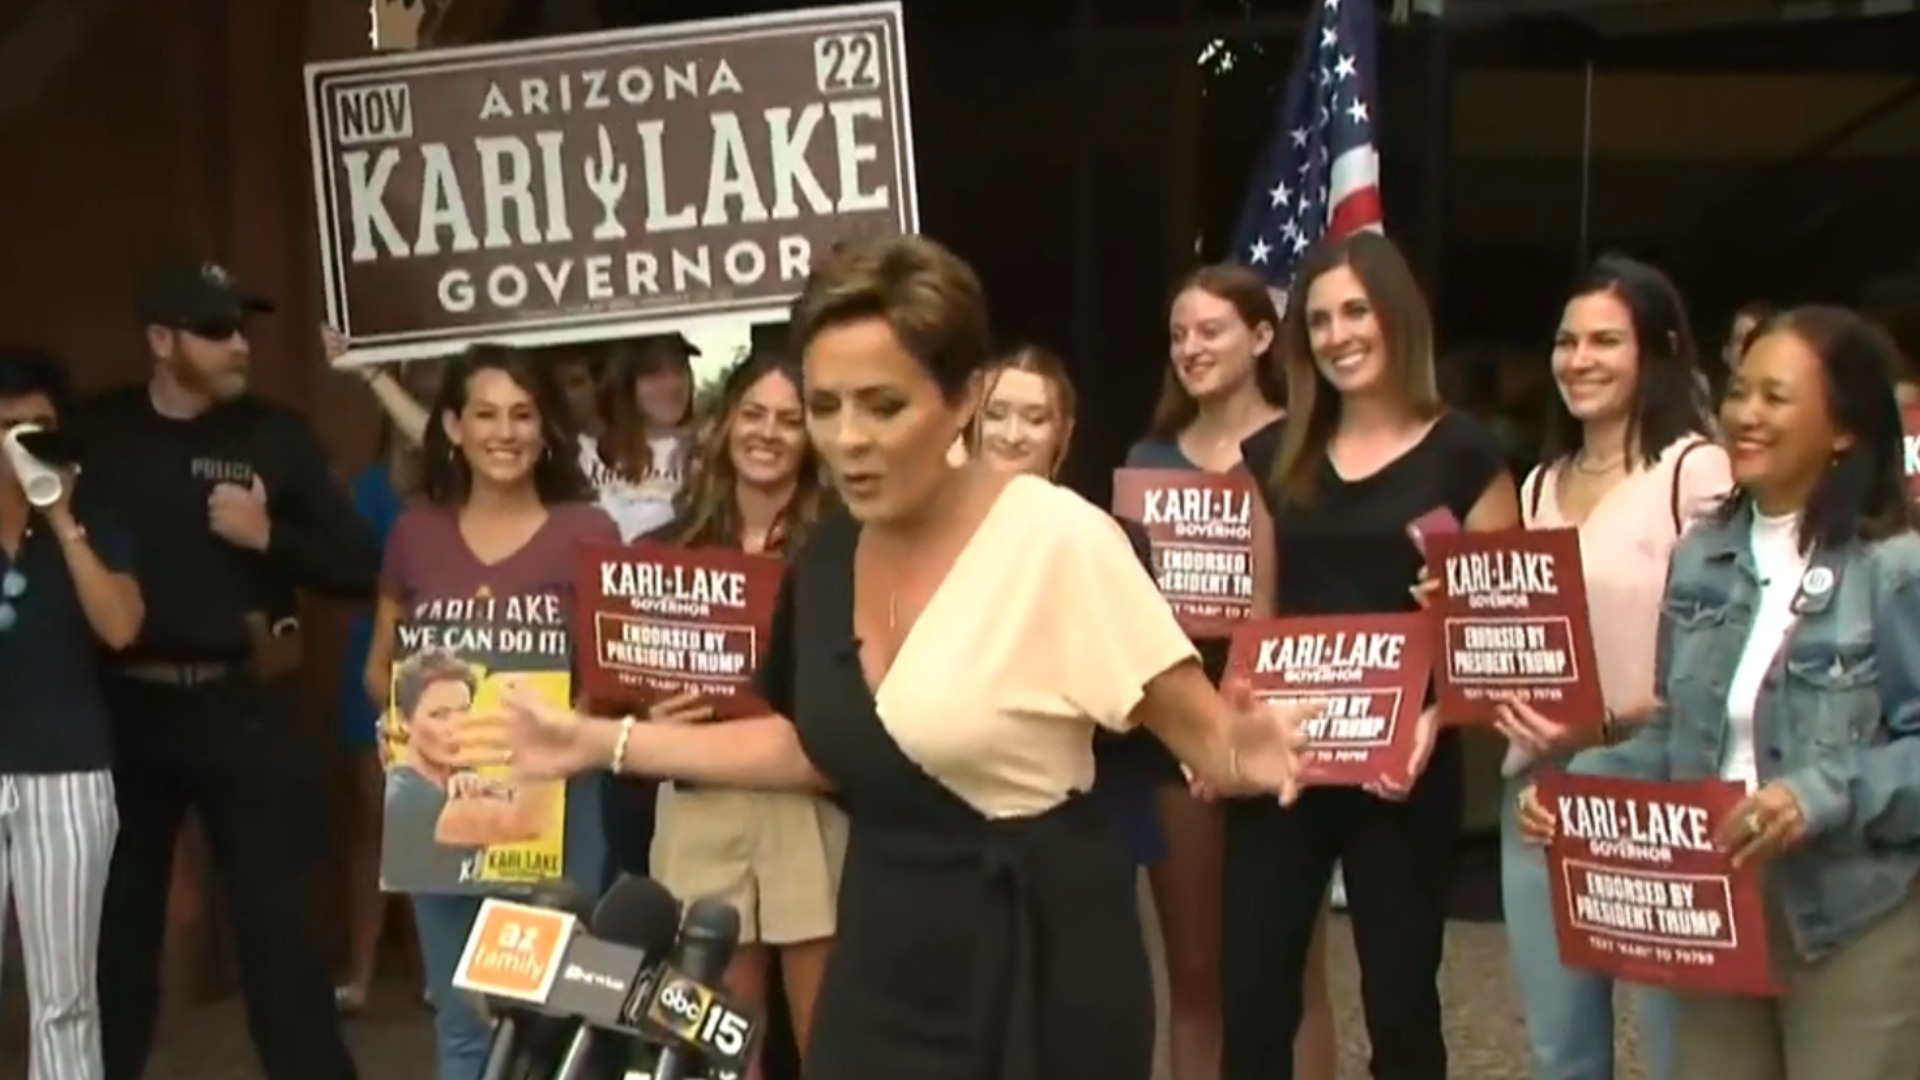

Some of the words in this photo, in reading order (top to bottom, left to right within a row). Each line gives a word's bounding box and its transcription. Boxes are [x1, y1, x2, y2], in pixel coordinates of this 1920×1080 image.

[821, 36, 877, 88] 22
[480, 59, 743, 120] ARIZONA
[341, 87, 406, 137] NOV
[342, 131, 572, 264] KARI
[637, 98, 889, 232] LAKE
[437, 236, 811, 314] GOVERNOR
[631, 598, 710, 617] GOVERNOR
[399, 624, 437, 649] WE
[443, 626, 493, 652] CAN
[500, 628, 533, 653] DO
[623, 622, 700, 651] ENDORSED
[704, 631, 726, 653] BY
[1464, 625, 1525, 649] ENDORSED
[1527, 625, 1545, 650] BY
[607, 639, 685, 670] PRESIDENT
[690, 652, 745, 674] TRUMP
[1454, 651, 1515, 675] PRESIDENT
[1516, 650, 1566, 675] TRUMP
[1330, 716, 1385, 739] TRUMP
[1589, 840, 1673, 862] GOVERNOR
[1586, 871, 1667, 906] ENDORSED
[1670, 882, 1694, 909] BY
[1576, 893, 1654, 931] PRESIDENT
[1656, 908, 1722, 938] TRUMP
[498, 921, 539, 951] az
[474, 944, 544, 982] family
[661, 986, 701, 1020] abc
[701, 1003, 749, 1056] 15
